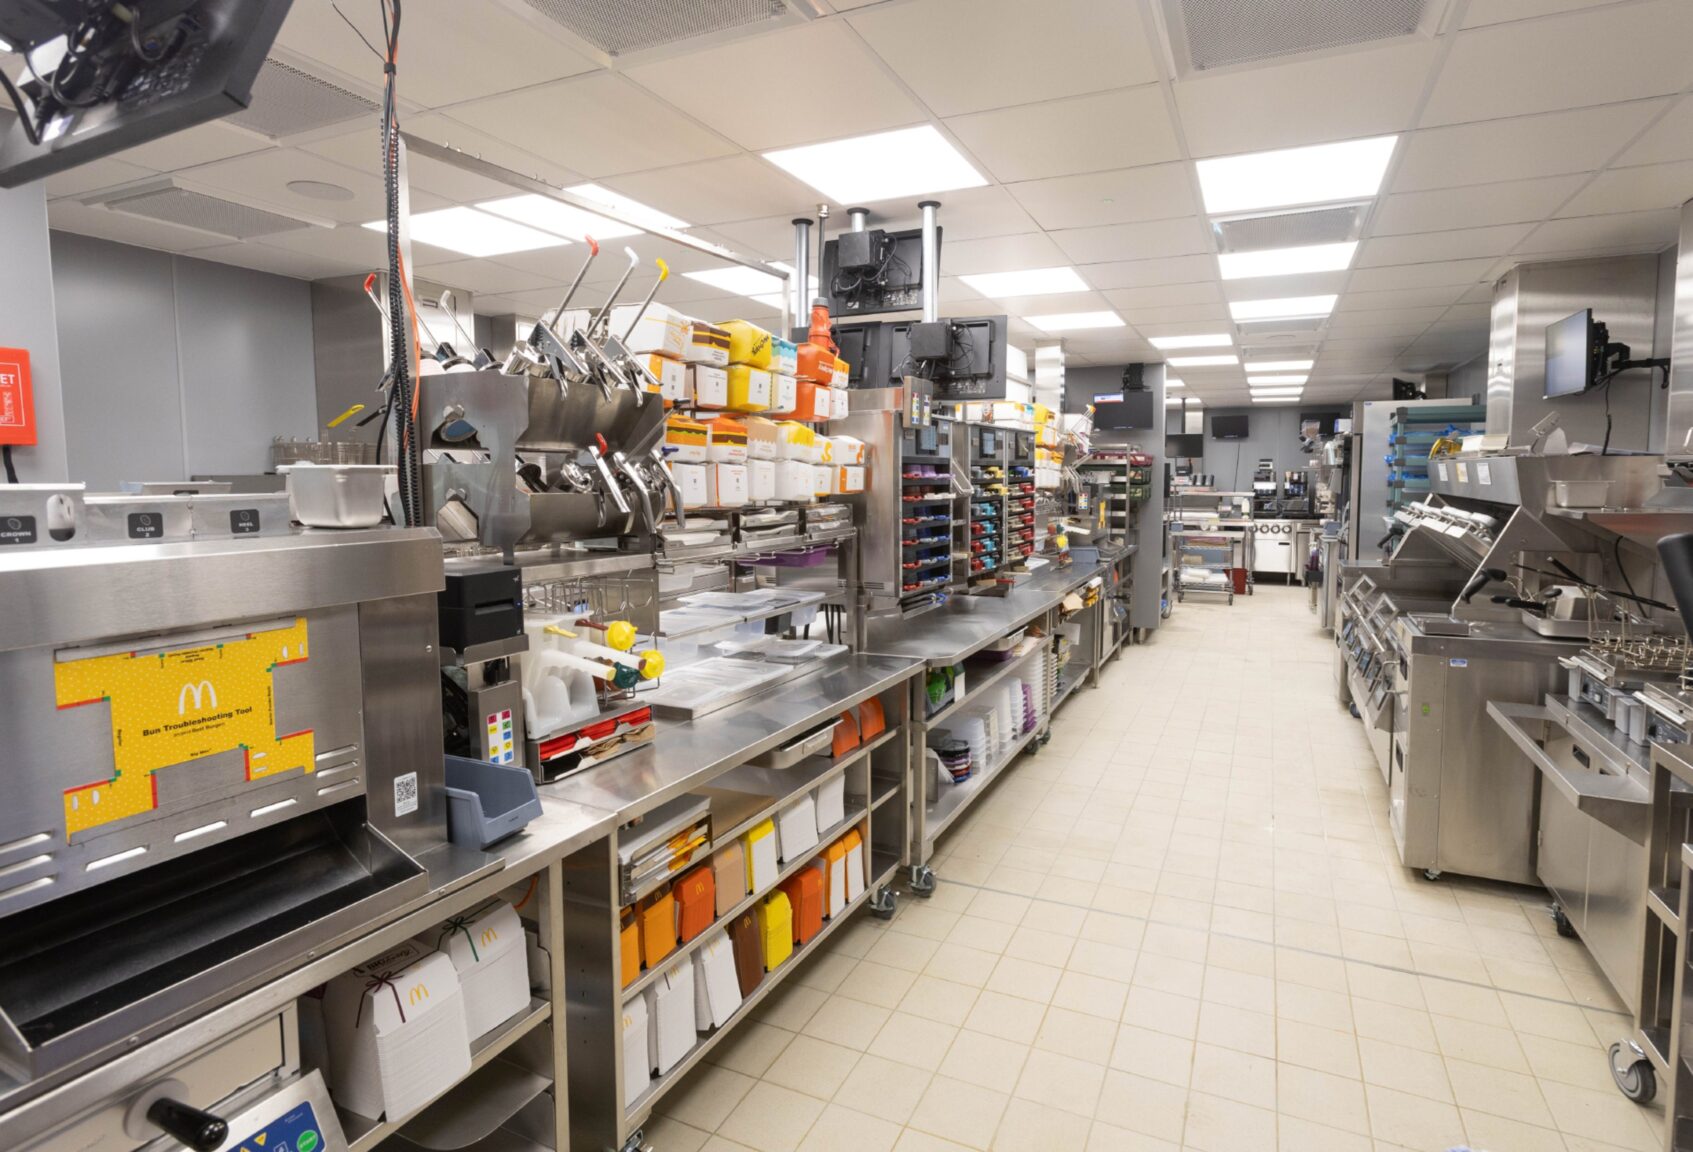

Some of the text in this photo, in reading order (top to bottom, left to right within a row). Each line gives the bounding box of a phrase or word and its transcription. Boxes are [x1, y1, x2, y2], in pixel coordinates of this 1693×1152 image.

[142, 727, 162, 737] Bun
[163, 711, 234, 732] Troubleshooting
[235, 706, 253, 716] Tool
